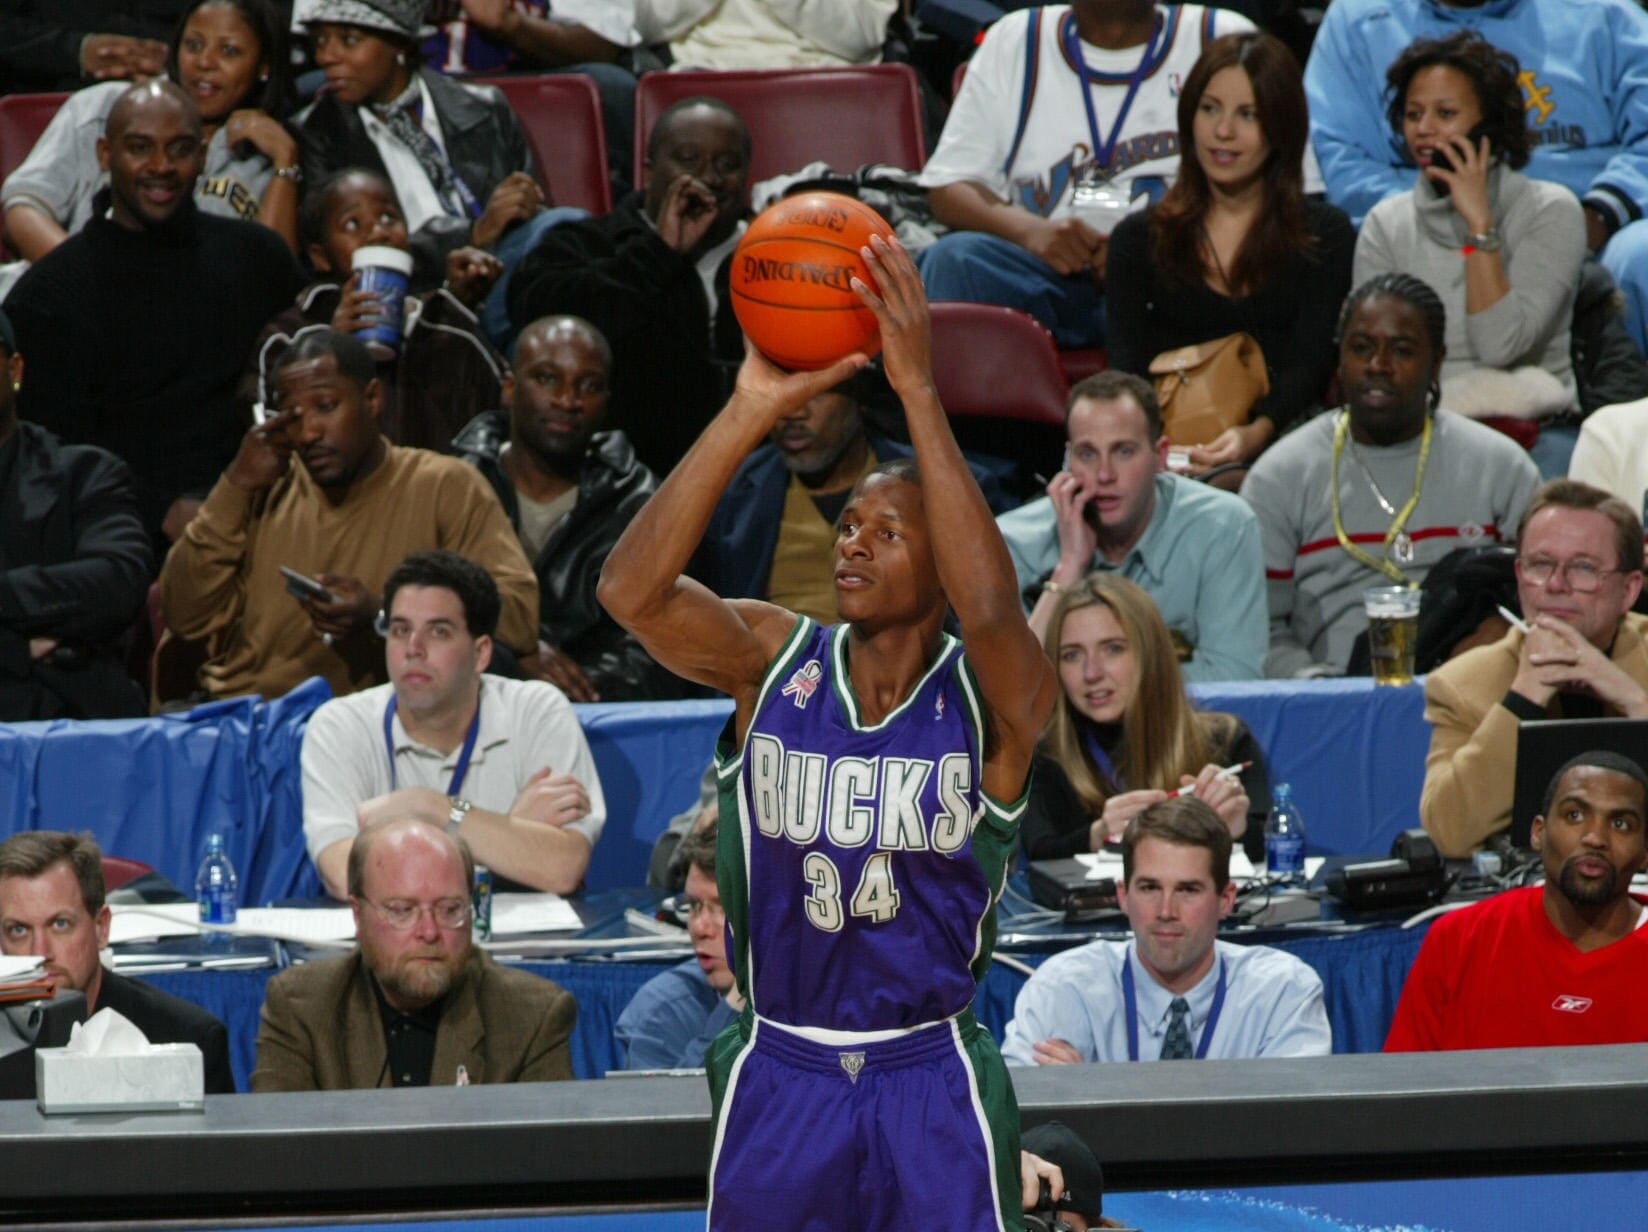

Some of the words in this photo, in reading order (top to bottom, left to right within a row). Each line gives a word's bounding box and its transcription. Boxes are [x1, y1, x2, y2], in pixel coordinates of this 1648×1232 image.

[743, 255, 858, 293] SPALDING
[750, 732, 972, 853] BUCKS
[803, 851, 900, 933] 34
